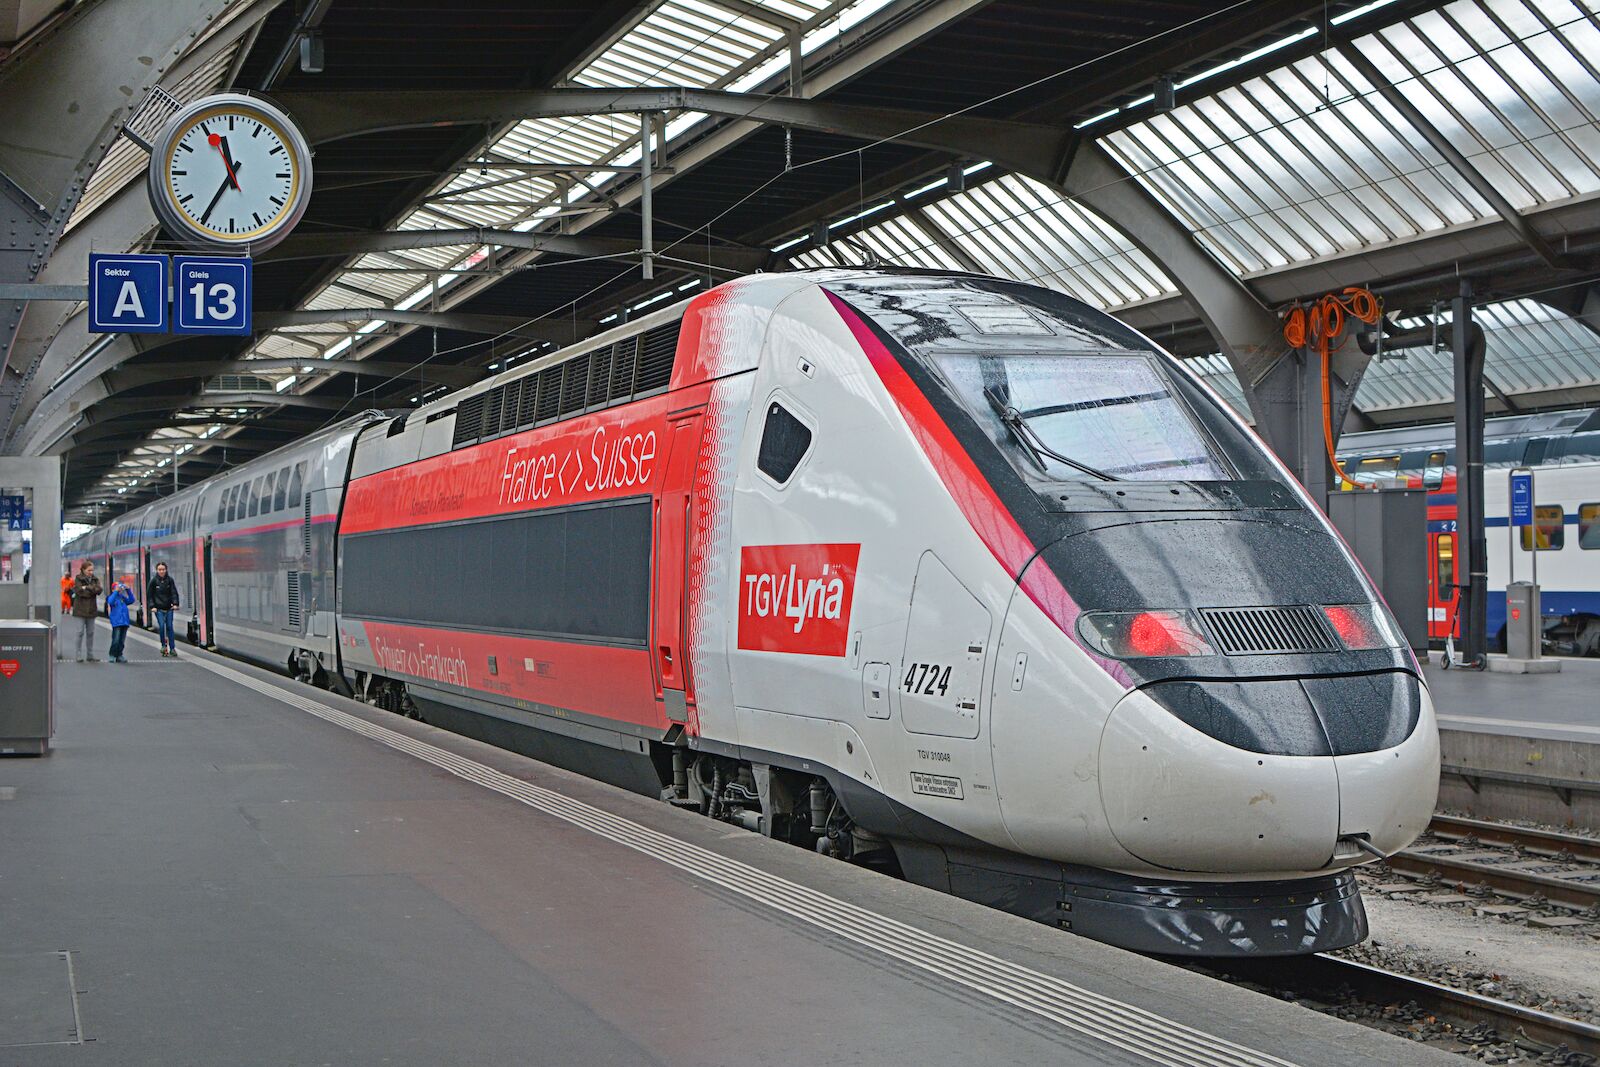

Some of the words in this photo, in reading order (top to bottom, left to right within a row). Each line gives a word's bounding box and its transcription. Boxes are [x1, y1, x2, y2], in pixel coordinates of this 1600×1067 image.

[104, 268, 131, 277] Sektor
[189, 271, 210, 279] Gleis
[112, 280, 145, 318] A
[189, 282, 237, 320] 13
[499, 448, 556, 505] France
[585, 419, 657, 492] Suisse
[13, 519, 20, 529] A
[1451, 520, 1457, 532] 2
[745, 573, 787, 617] TGV
[785, 563, 844, 634] Lyria
[376, 636, 407, 673] Schweiz
[419, 643, 469, 688] Frankreich
[904, 663, 952, 697] 4724
[917, 749, 930, 760] TGV
[930, 751, 951, 762] 310048
